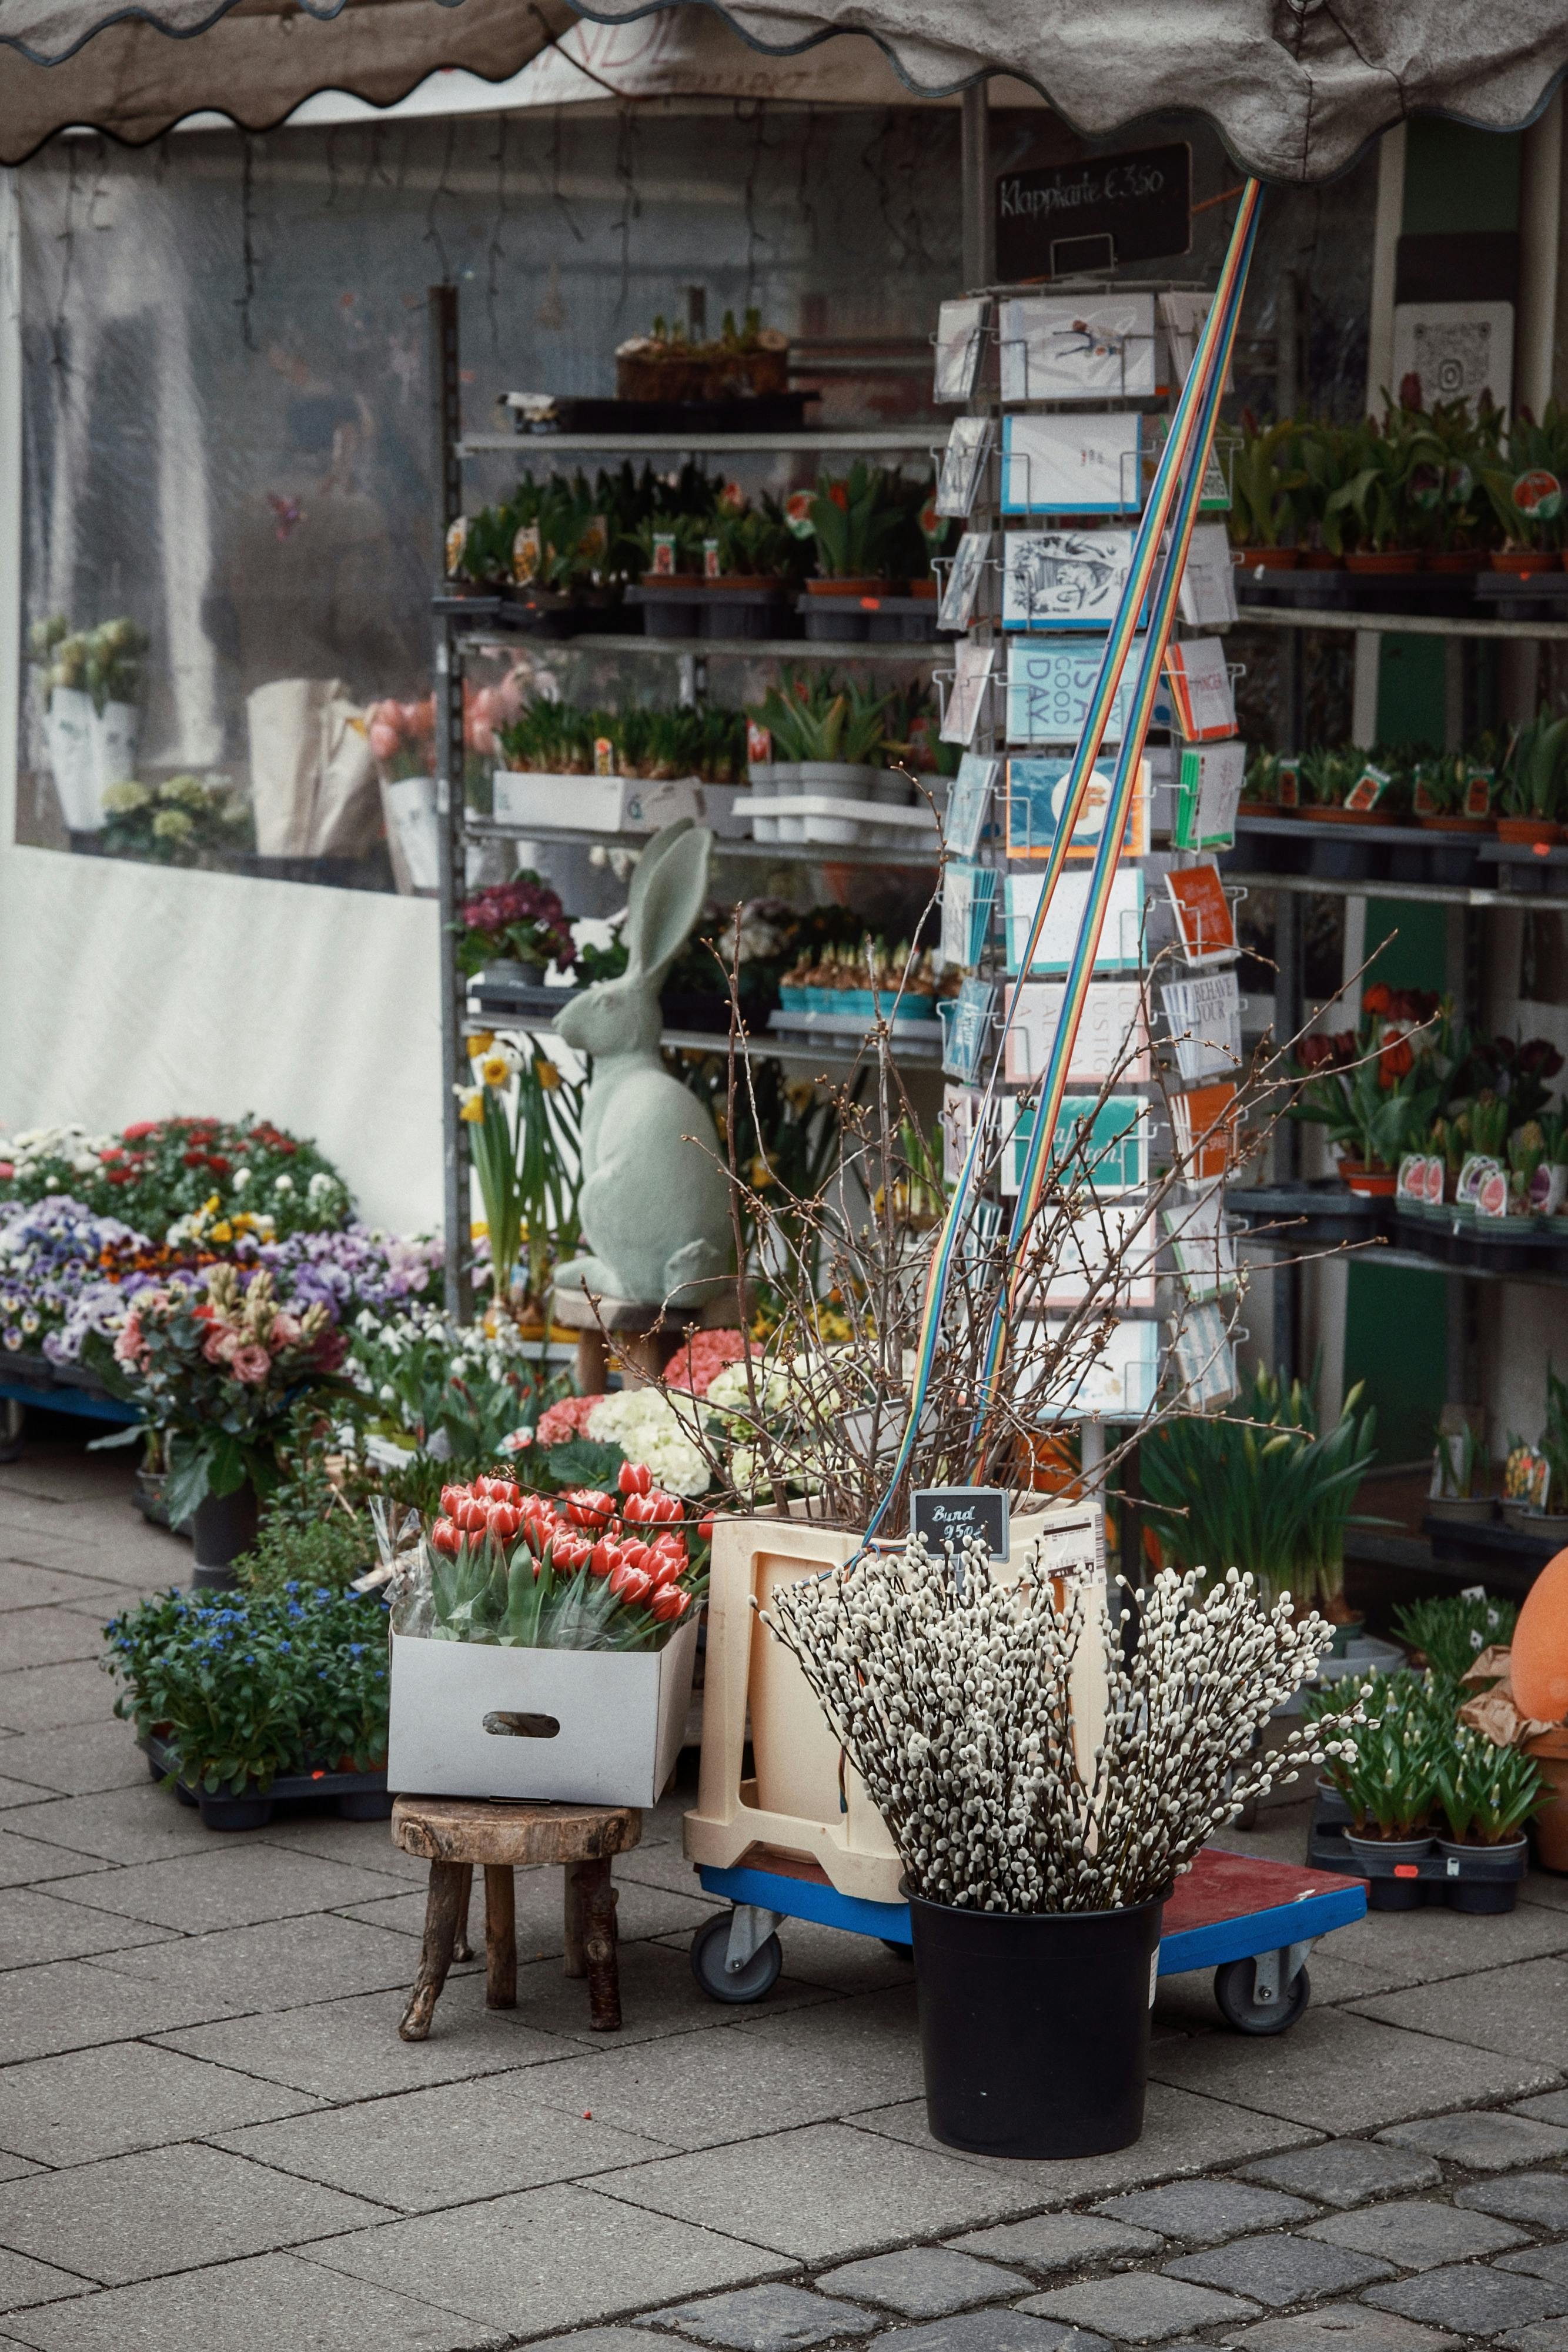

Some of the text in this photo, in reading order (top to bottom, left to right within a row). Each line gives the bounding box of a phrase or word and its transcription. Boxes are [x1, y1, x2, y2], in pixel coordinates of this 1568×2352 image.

[1001, 171, 1101, 219] Klappkarte
[1026, 659, 1051, 724] DAY
[1054, 656, 1072, 724] GOOD
[1193, 975, 1233, 1003] BEHAVE
[1092, 987, 1109, 1073] LUSTIG
[932, 1505, 975, 1522] Bund
